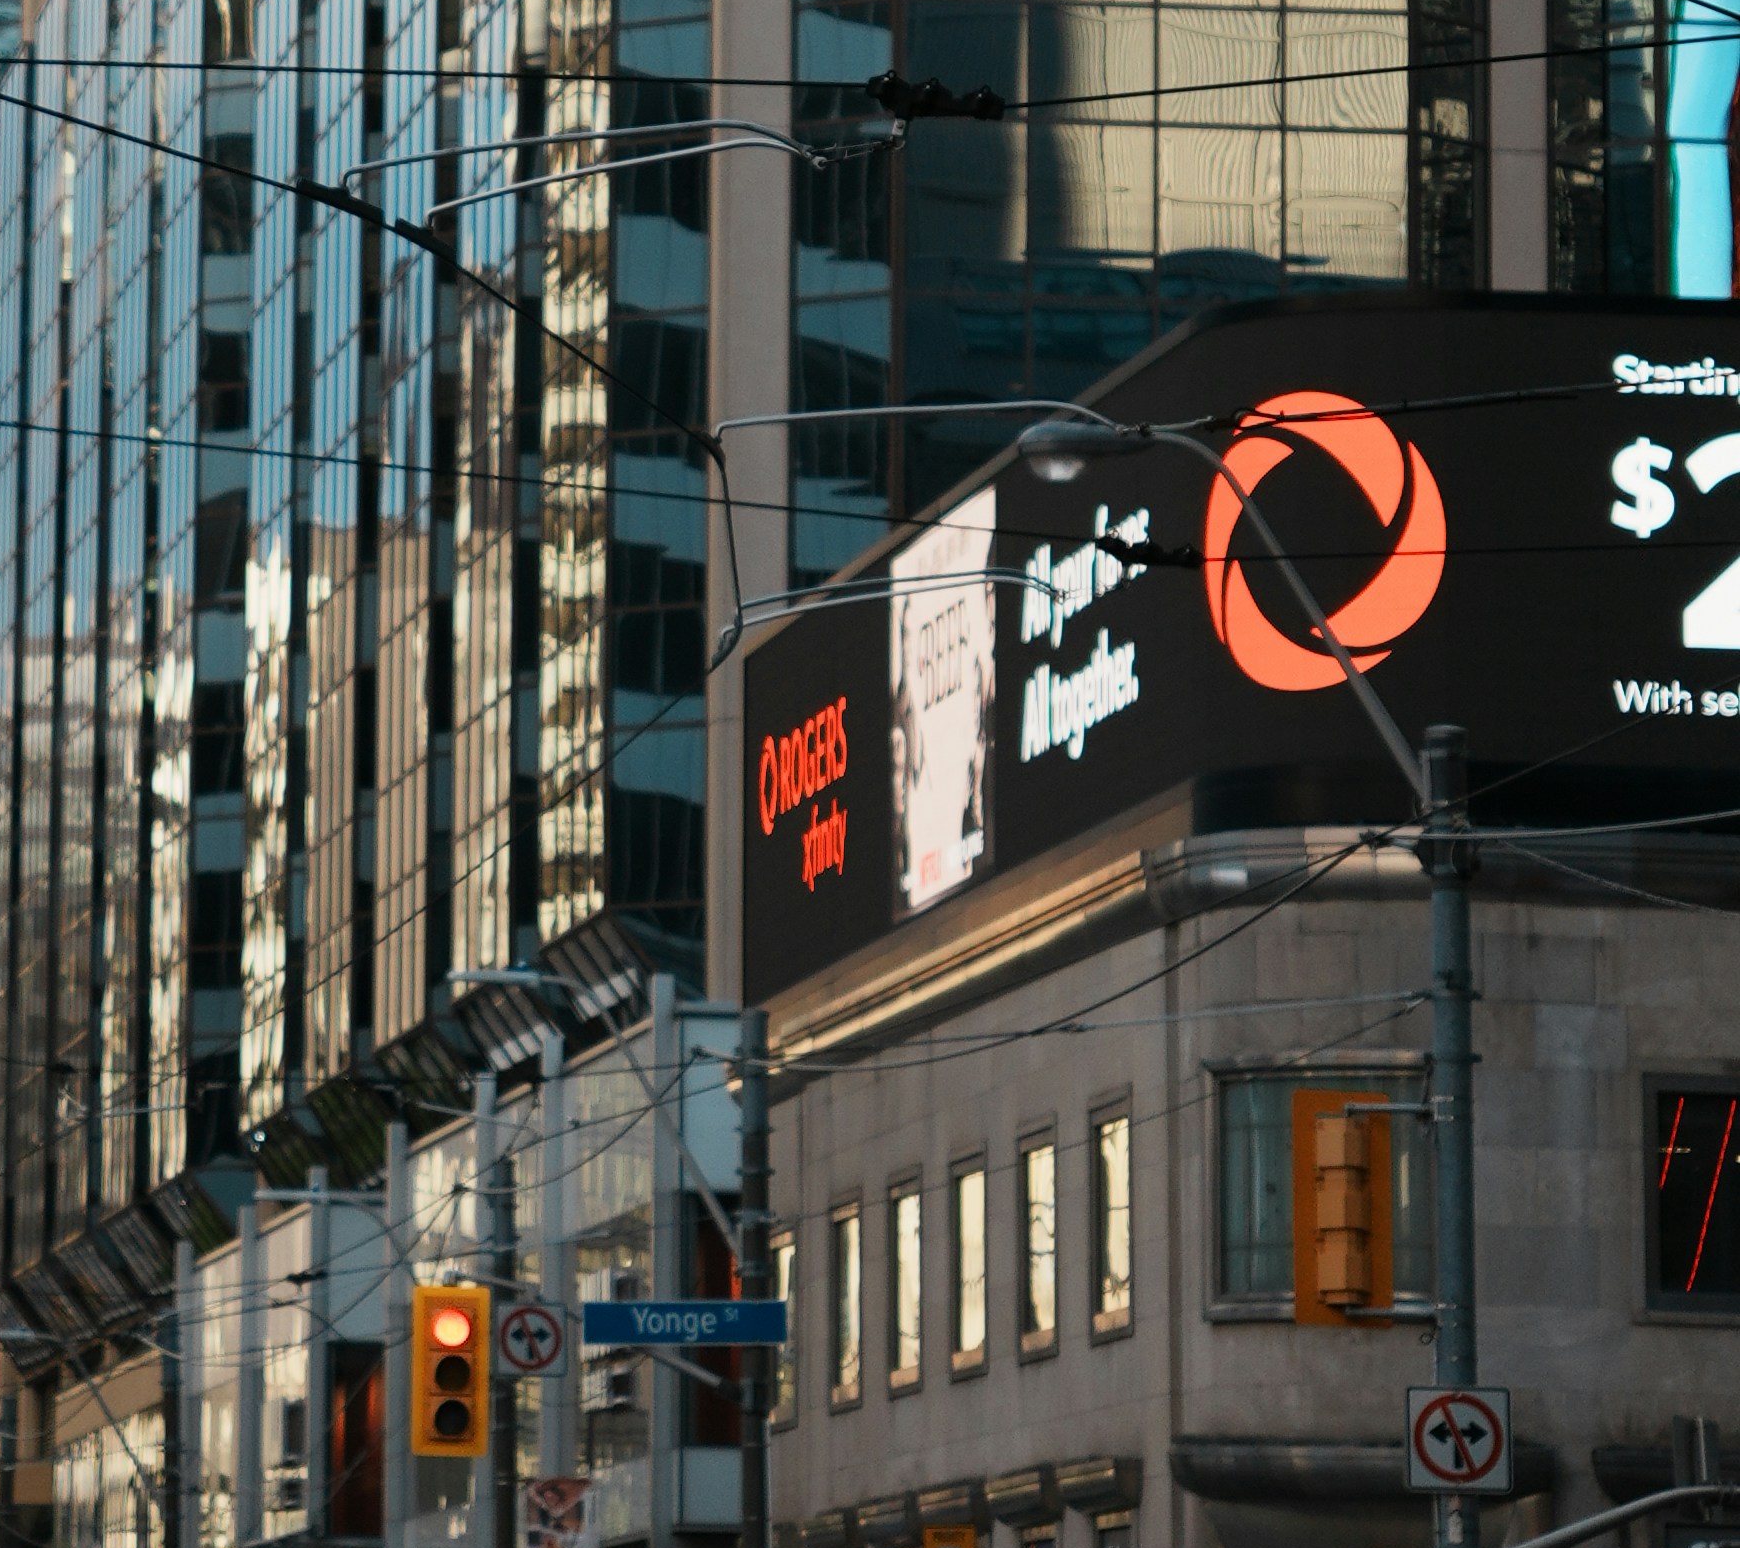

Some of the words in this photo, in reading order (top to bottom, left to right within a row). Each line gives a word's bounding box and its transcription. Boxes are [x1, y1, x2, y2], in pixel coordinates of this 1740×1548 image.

[1613, 354, 1740, 405] Startin
[1021, 544, 1052, 645] All
[1051, 541, 1096, 650] your
[1020, 664, 1051, 763] All
[1051, 627, 1140, 761] together.
[1612, 679, 1693, 715] With
[1700, 682, 1740, 717] se
[779, 696, 848, 815] ROGERS
[631, 1306, 718, 1342] Yonge
